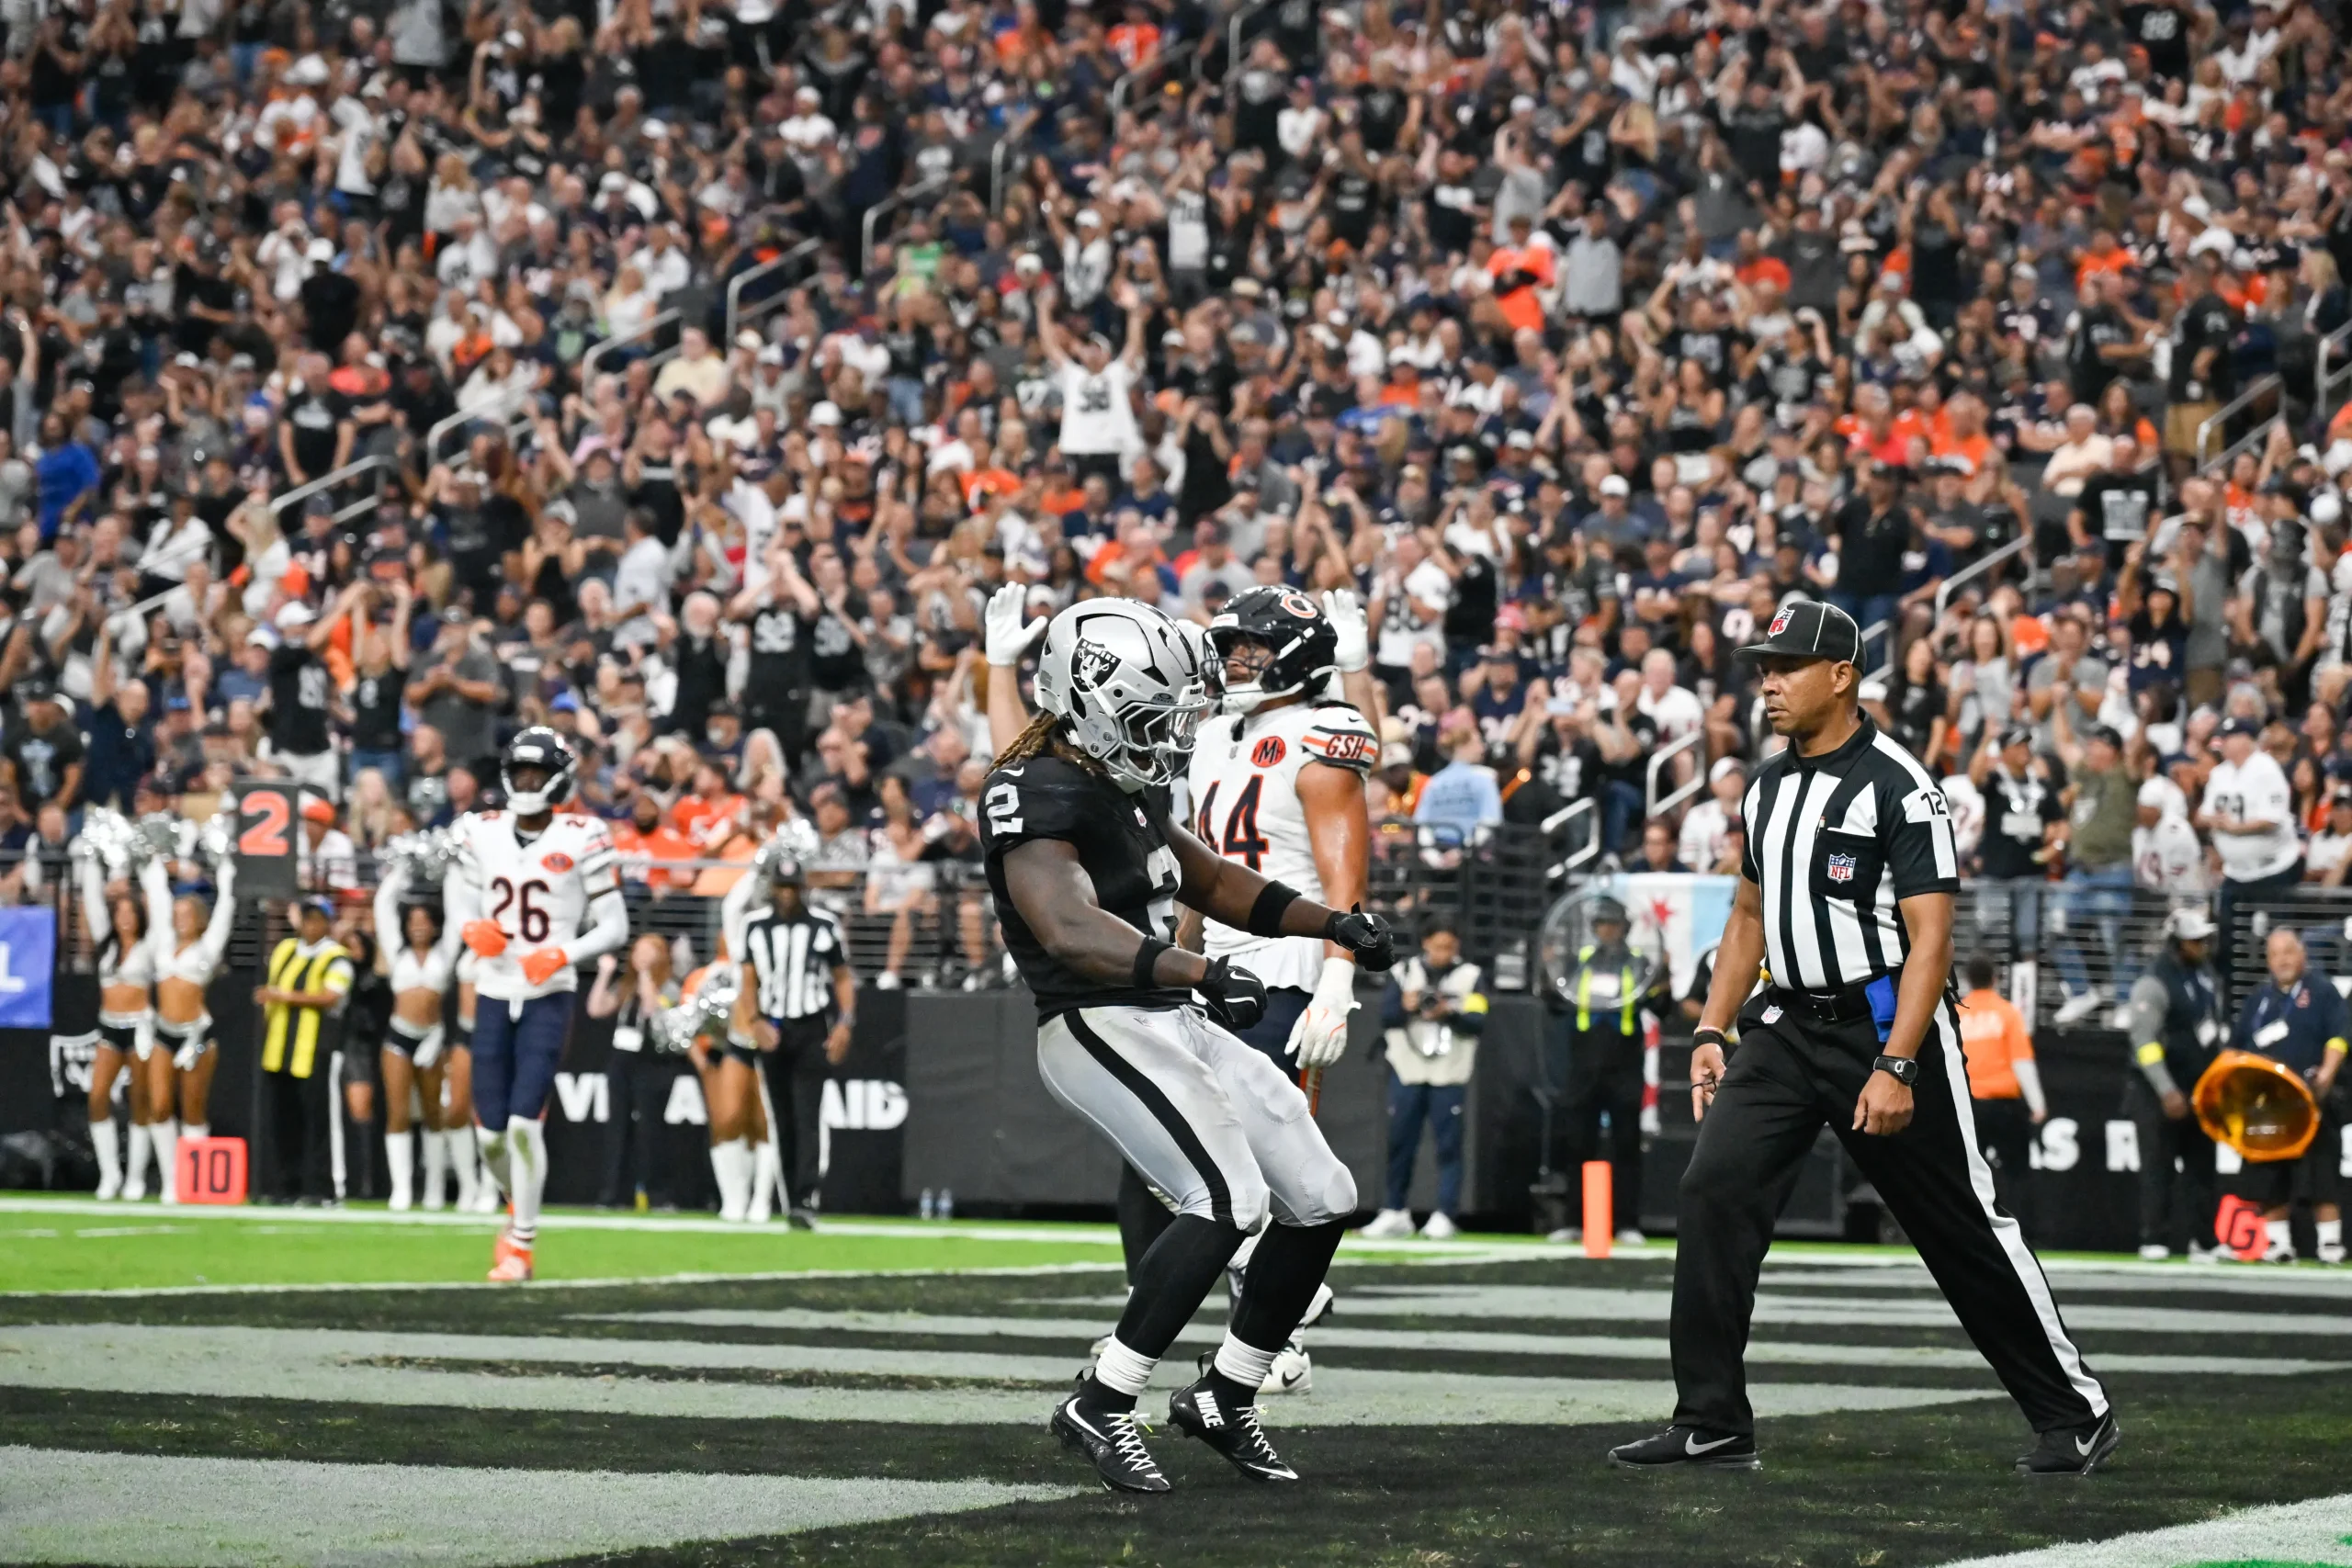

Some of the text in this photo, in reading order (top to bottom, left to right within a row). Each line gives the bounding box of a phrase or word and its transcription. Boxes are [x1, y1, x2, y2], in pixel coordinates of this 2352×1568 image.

[1326, 734, 1366, 760] GSH
[240, 790, 289, 856] 2
[985, 783, 1023, 837] 2
[1198, 774, 1270, 874] 44
[1147, 844, 1182, 947] 2
[1830, 865, 1850, 880] NFL
[492, 876, 550, 943] 26
[189, 1149, 232, 1193] 10
[2227, 1206, 2262, 1250] G
[1194, 1390, 1225, 1428] NIKE
